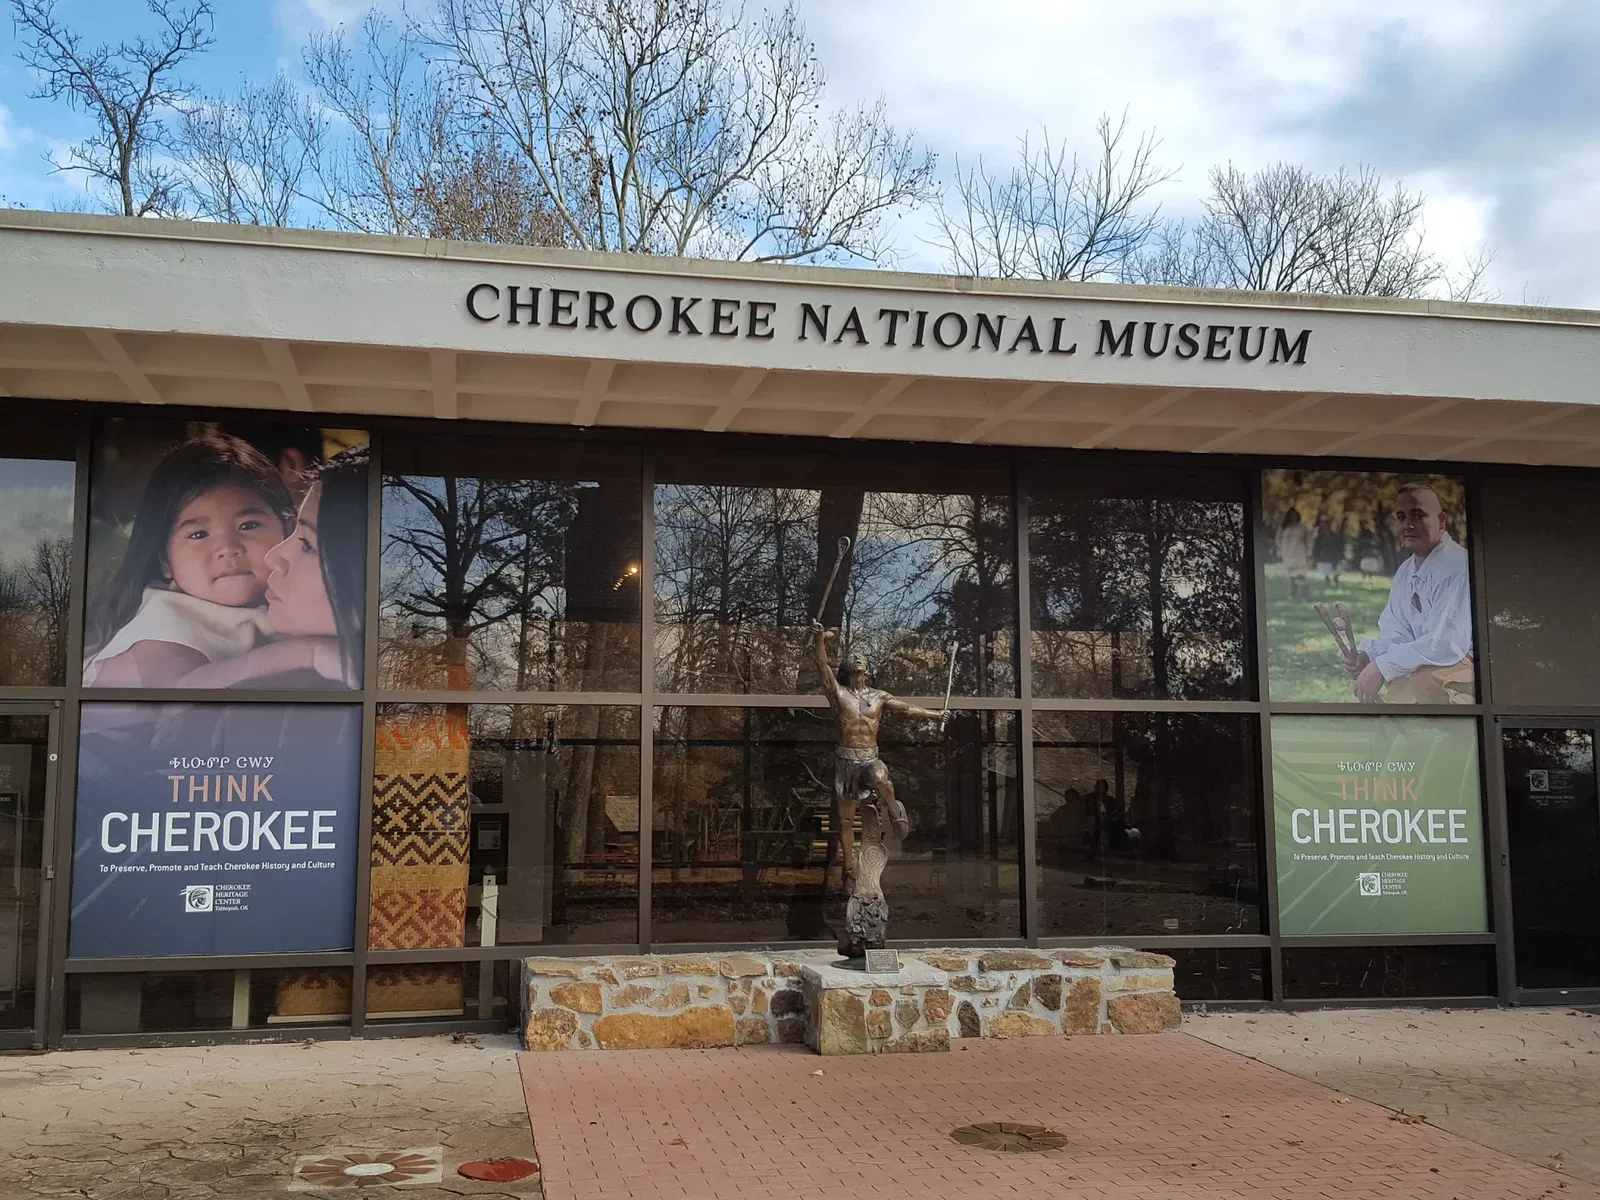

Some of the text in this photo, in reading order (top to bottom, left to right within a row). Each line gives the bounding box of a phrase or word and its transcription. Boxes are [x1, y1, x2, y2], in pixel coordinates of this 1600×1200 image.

[466, 282, 1313, 366] CHEROKEE NATIONAL MUSEUM
[168, 774, 274, 802] THINK
[1338, 776, 1418, 801] THINK
[101, 810, 337, 853] CHEROKEE
[1291, 808, 1468, 844] CHEROKEE
[110, 864, 148, 874] Preserve,
[149, 864, 182, 872] Promote
[184, 863, 199, 871] and
[201, 863, 223, 871] Teach
[224, 862, 260, 871] Cherokee
[262, 862, 290, 871] History
[291, 861, 306, 869] and
[307, 860, 335, 869] Culture
[1293, 853, 1300, 861] To
[1301, 853, 1329, 861] Preserve,
[1330, 853, 1355, 861] Promote
[1356, 853, 1367, 861] and
[1368, 853, 1385, 861] Teach
[1386, 853, 1413, 861] Cherokee
[1414, 853, 1436, 862] History
